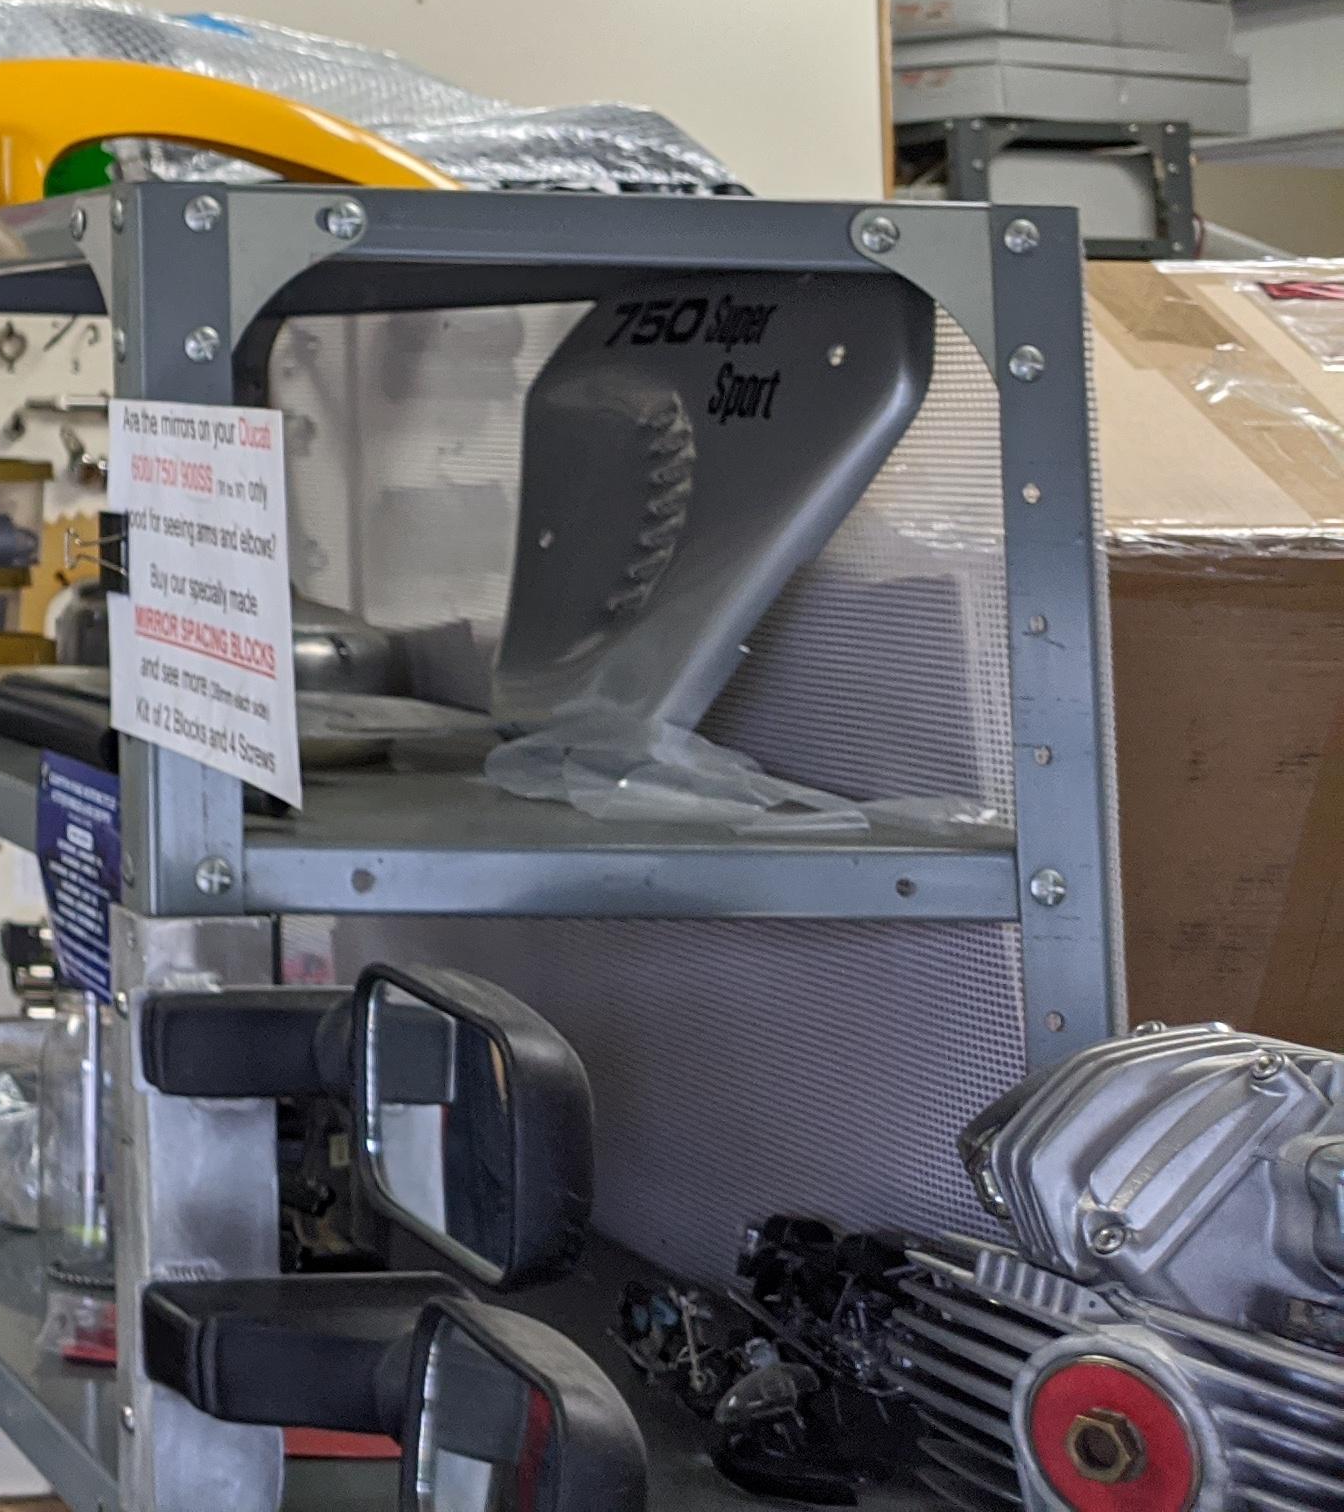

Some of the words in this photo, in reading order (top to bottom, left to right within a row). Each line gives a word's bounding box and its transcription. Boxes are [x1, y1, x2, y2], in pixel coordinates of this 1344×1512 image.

[605, 298, 709, 347] 750
[705, 293, 778, 353] Super
[708, 361, 781, 426] Sport
[141, 408, 157, 435] the
[161, 411, 197, 439] mirrors
[199, 419, 210, 439] on
[213, 420, 235, 449] your
[238, 417, 272, 449] Ducati
[248, 476, 268, 510] only
[129, 508, 147, 530] ood
[149, 507, 161, 532] for
[163, 513, 194, 547] seeing
[196, 522, 217, 546] arms
[220, 522, 238, 551] and
[240, 527, 277, 559] elbows?
[150, 562, 168, 596] Buy
[170, 573, 186, 595] our
[189, 578, 227, 613] specially
[229, 588, 258, 616] made
[134, 604, 178, 637] MIRROR
[181, 616, 228, 654] SPACING
[230, 630, 277, 671] BLOCKS
[141, 656, 159, 681] and
[162, 663, 179, 687] see
[182, 668, 208, 697] more
[136, 695, 150, 724] Kit
[152, 699, 162, 727] of
[163, 704, 171, 732] 2
[173, 707, 207, 745] Blocks
[209, 726, 228, 754] and
[229, 728, 236, 754] 4
[238, 731, 277, 774] Screws
